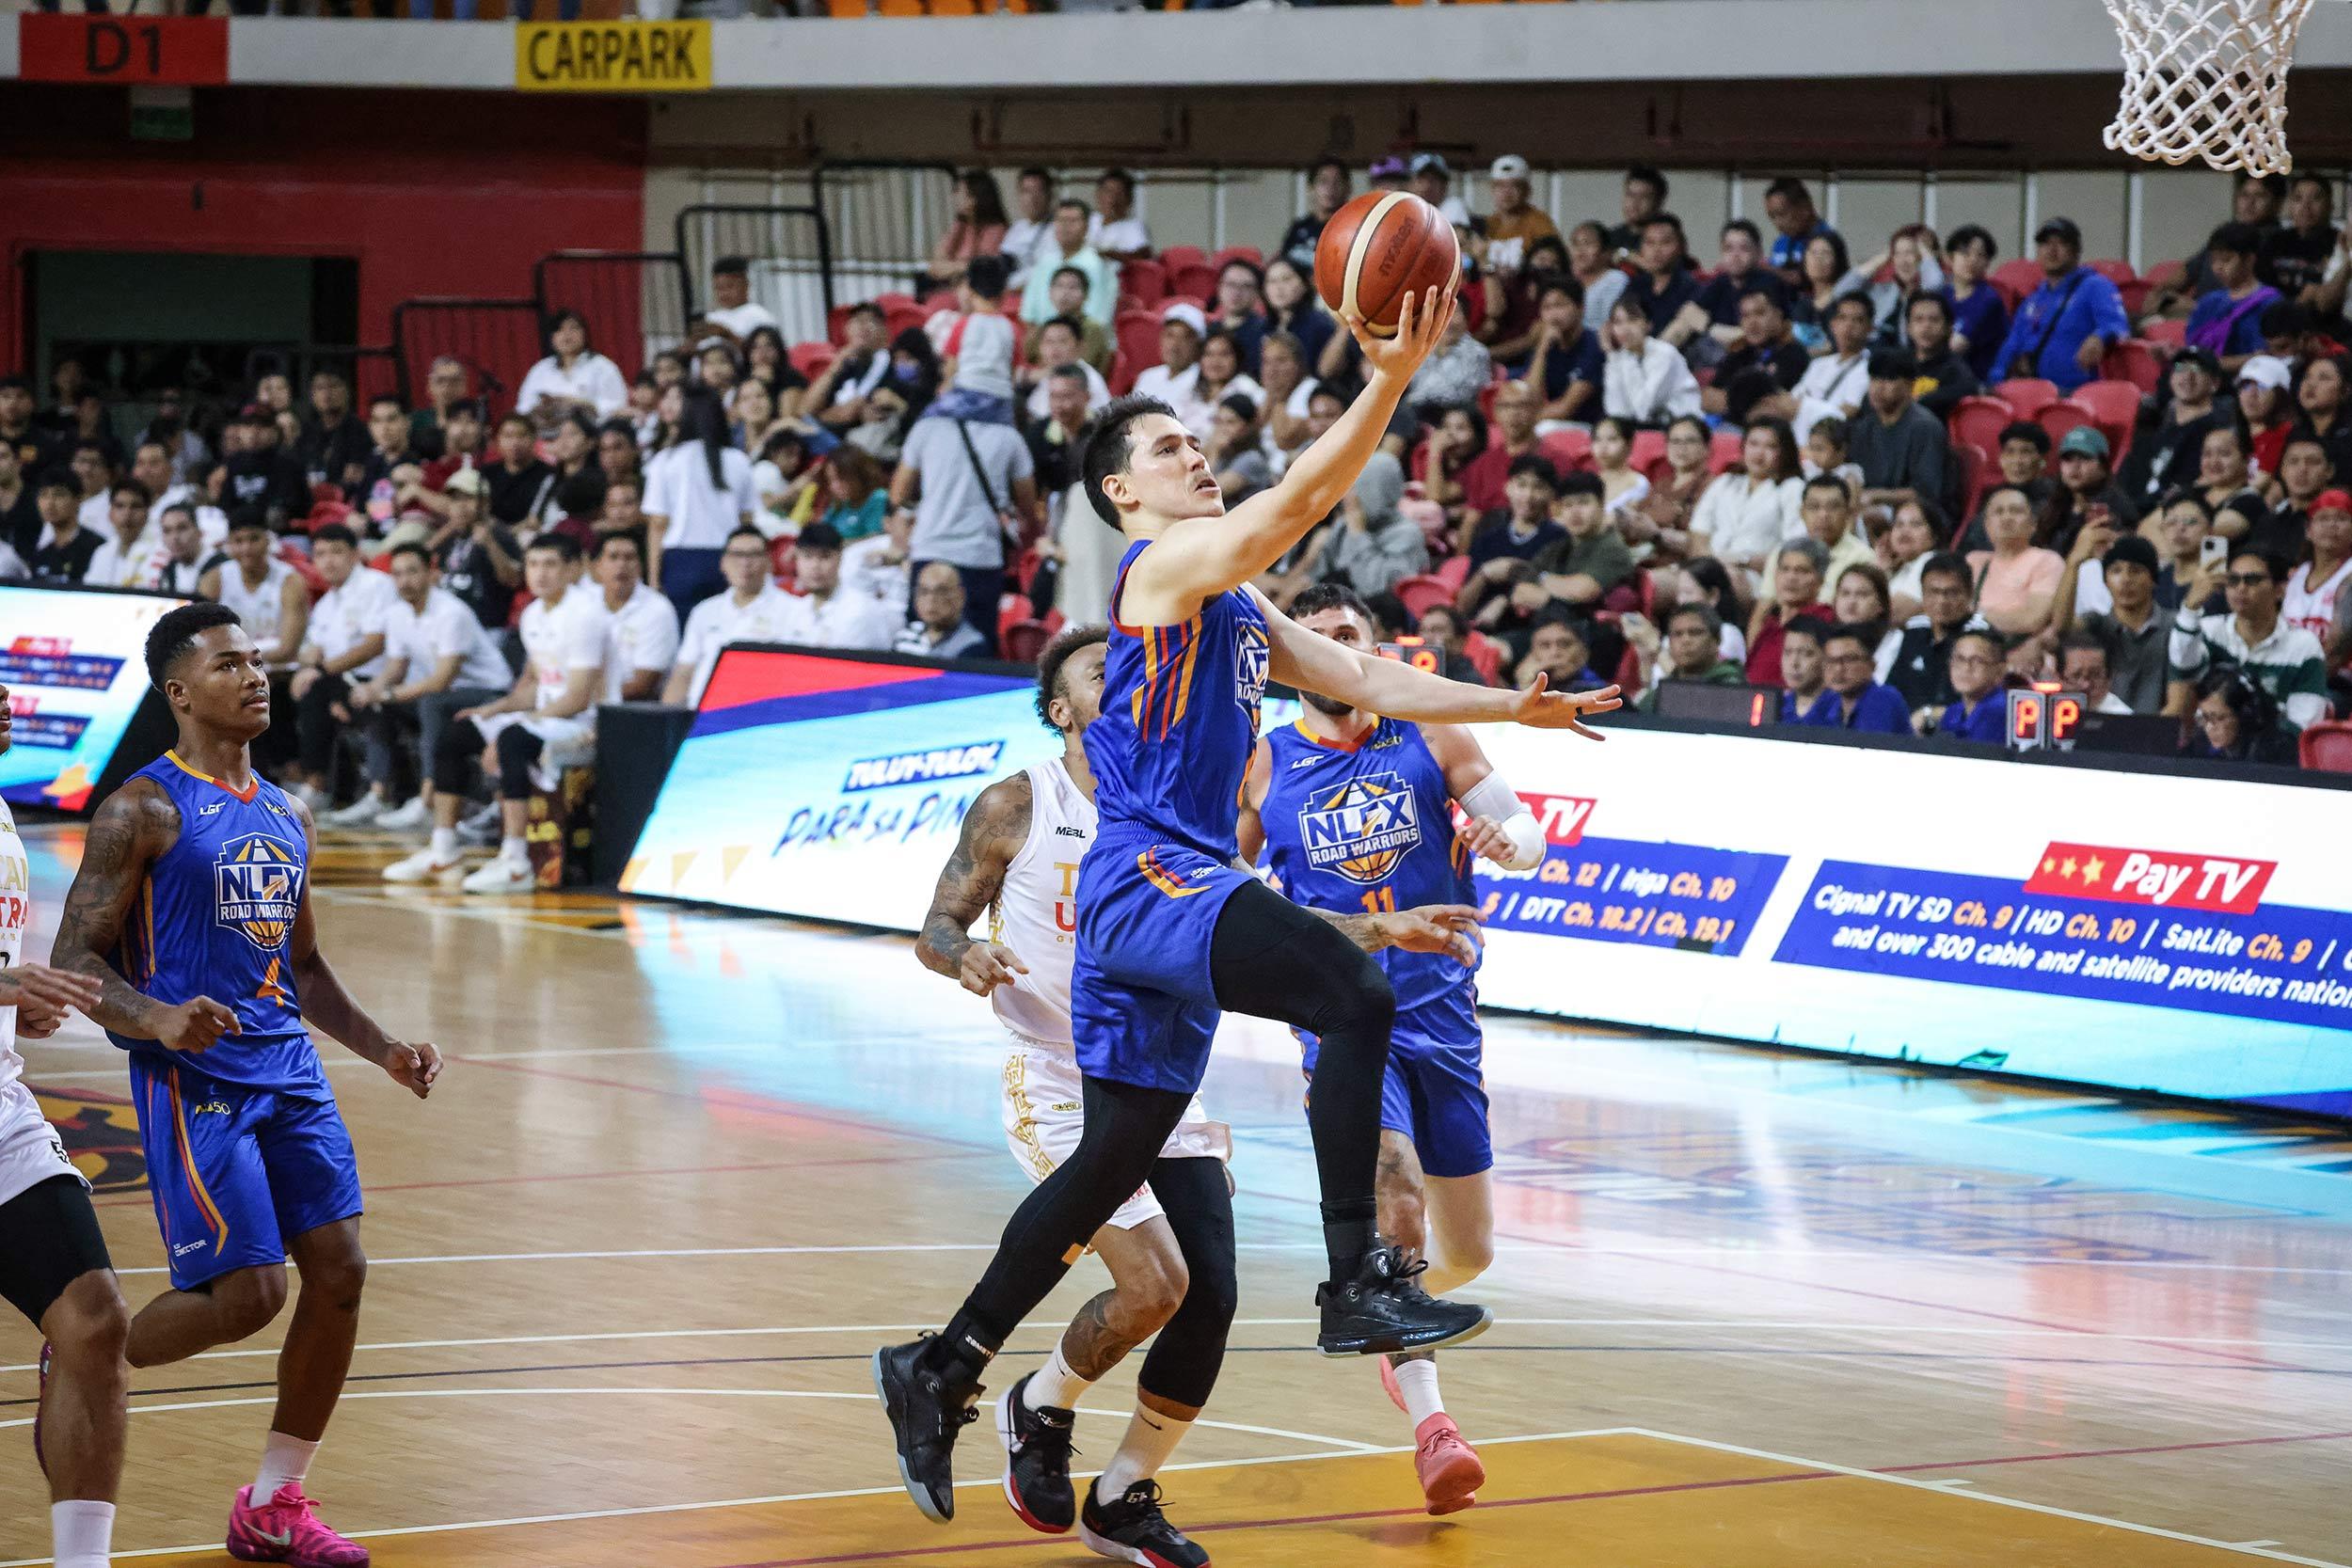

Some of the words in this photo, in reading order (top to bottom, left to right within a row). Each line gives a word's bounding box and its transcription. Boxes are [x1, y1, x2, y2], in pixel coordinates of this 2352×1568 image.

[86, 23, 161, 73] D1
[529, 28, 697, 81] CARPARK
[2016, 699, 2040, 737] P
[2053, 699, 2079, 738] P
[1539, 799, 1591, 837] TV
[1311, 846, 1347, 864] ROAD
[1351, 828, 1419, 855] WARRIORS
[1708, 877, 1737, 902] 10
[2112, 853, 2192, 904] Pay
[2195, 860, 2260, 903] TV
[220, 904, 251, 920] ROAD
[1360, 886, 1396, 913] 11
[1518, 895, 1567, 924] DTT
[1814, 884, 1886, 916] Cignal
[1884, 893, 1921, 919] TV
[1916, 896, 1953, 923] SD
[1992, 905, 2013, 931] 9
[2025, 908, 2065, 935] HD
[2106, 917, 2137, 944] 10
[2161, 922, 2246, 957] SatLite
[2290, 939, 2312, 964] 9
[1832, 925, 1880, 950] and
[1875, 931, 1929, 956] over
[1926, 933, 1977, 962] 300
[1976, 940, 2037, 969] cable
[2035, 948, 2086, 974] and
[2081, 954, 2170, 984] satellite
[2168, 965, 2283, 999] providers
